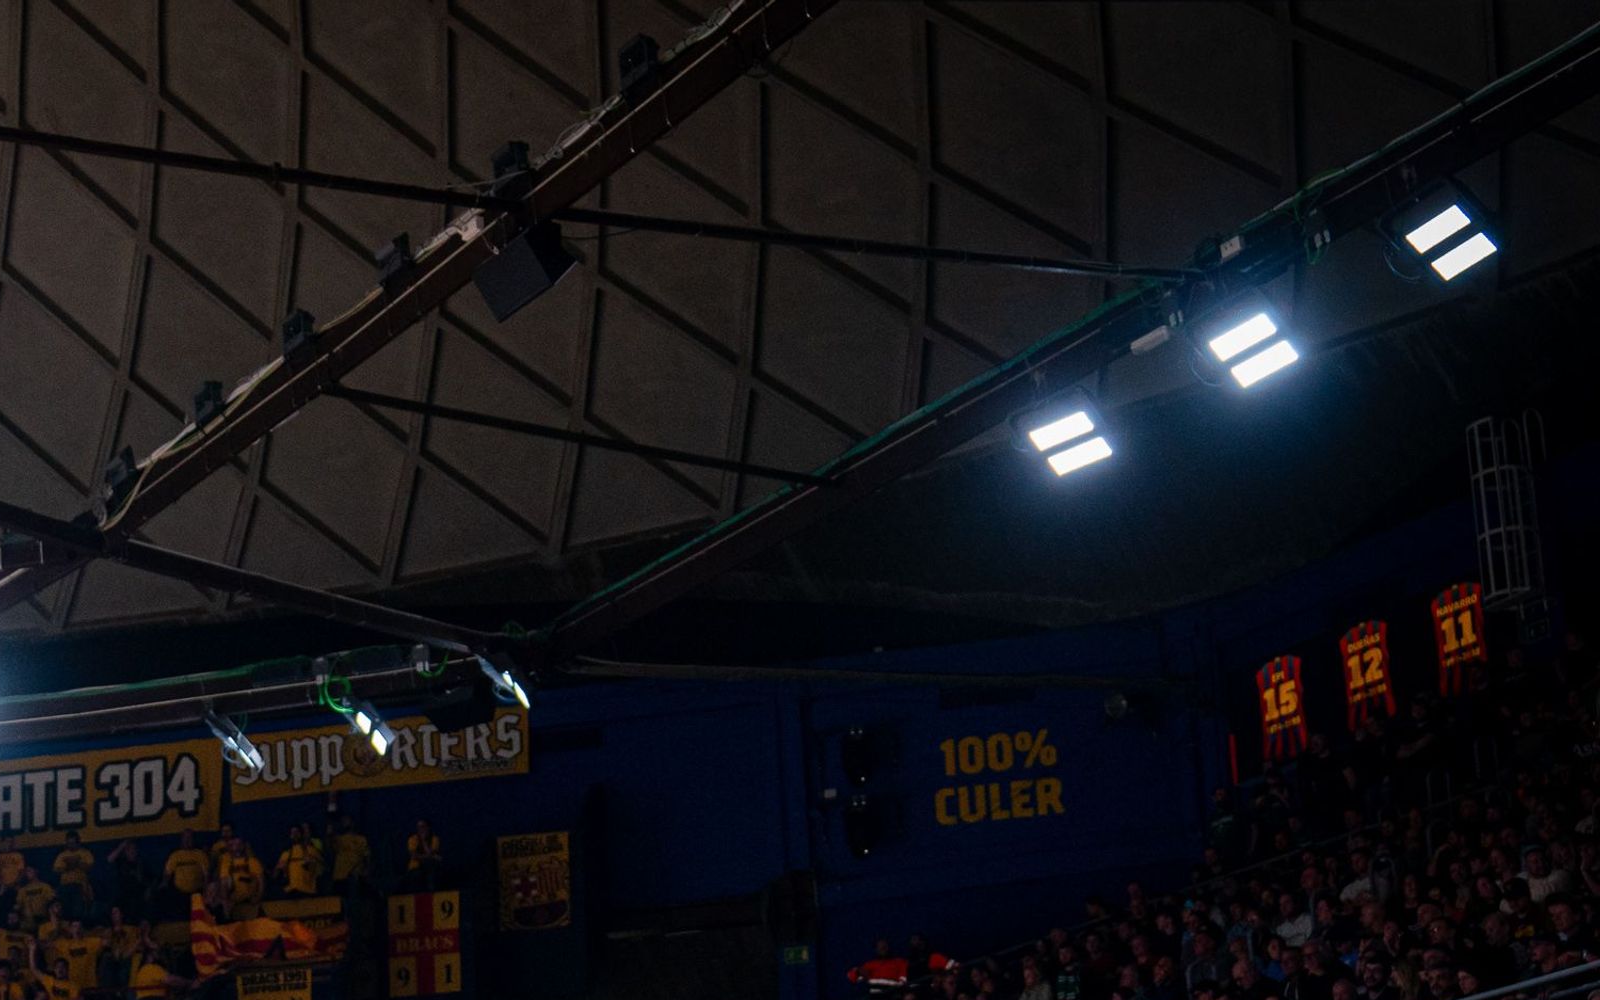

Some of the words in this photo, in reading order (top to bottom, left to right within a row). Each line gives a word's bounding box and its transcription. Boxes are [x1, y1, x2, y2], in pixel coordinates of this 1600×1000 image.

[1441, 609, 1478, 653] 11
[1347, 647, 1384, 690] 12
[1263, 680, 1298, 722] 15
[940, 728, 1057, 776] 100%
[99, 753, 200, 822] 304
[934, 776, 1066, 826] CULER
[396, 934, 456, 954] DRACS
